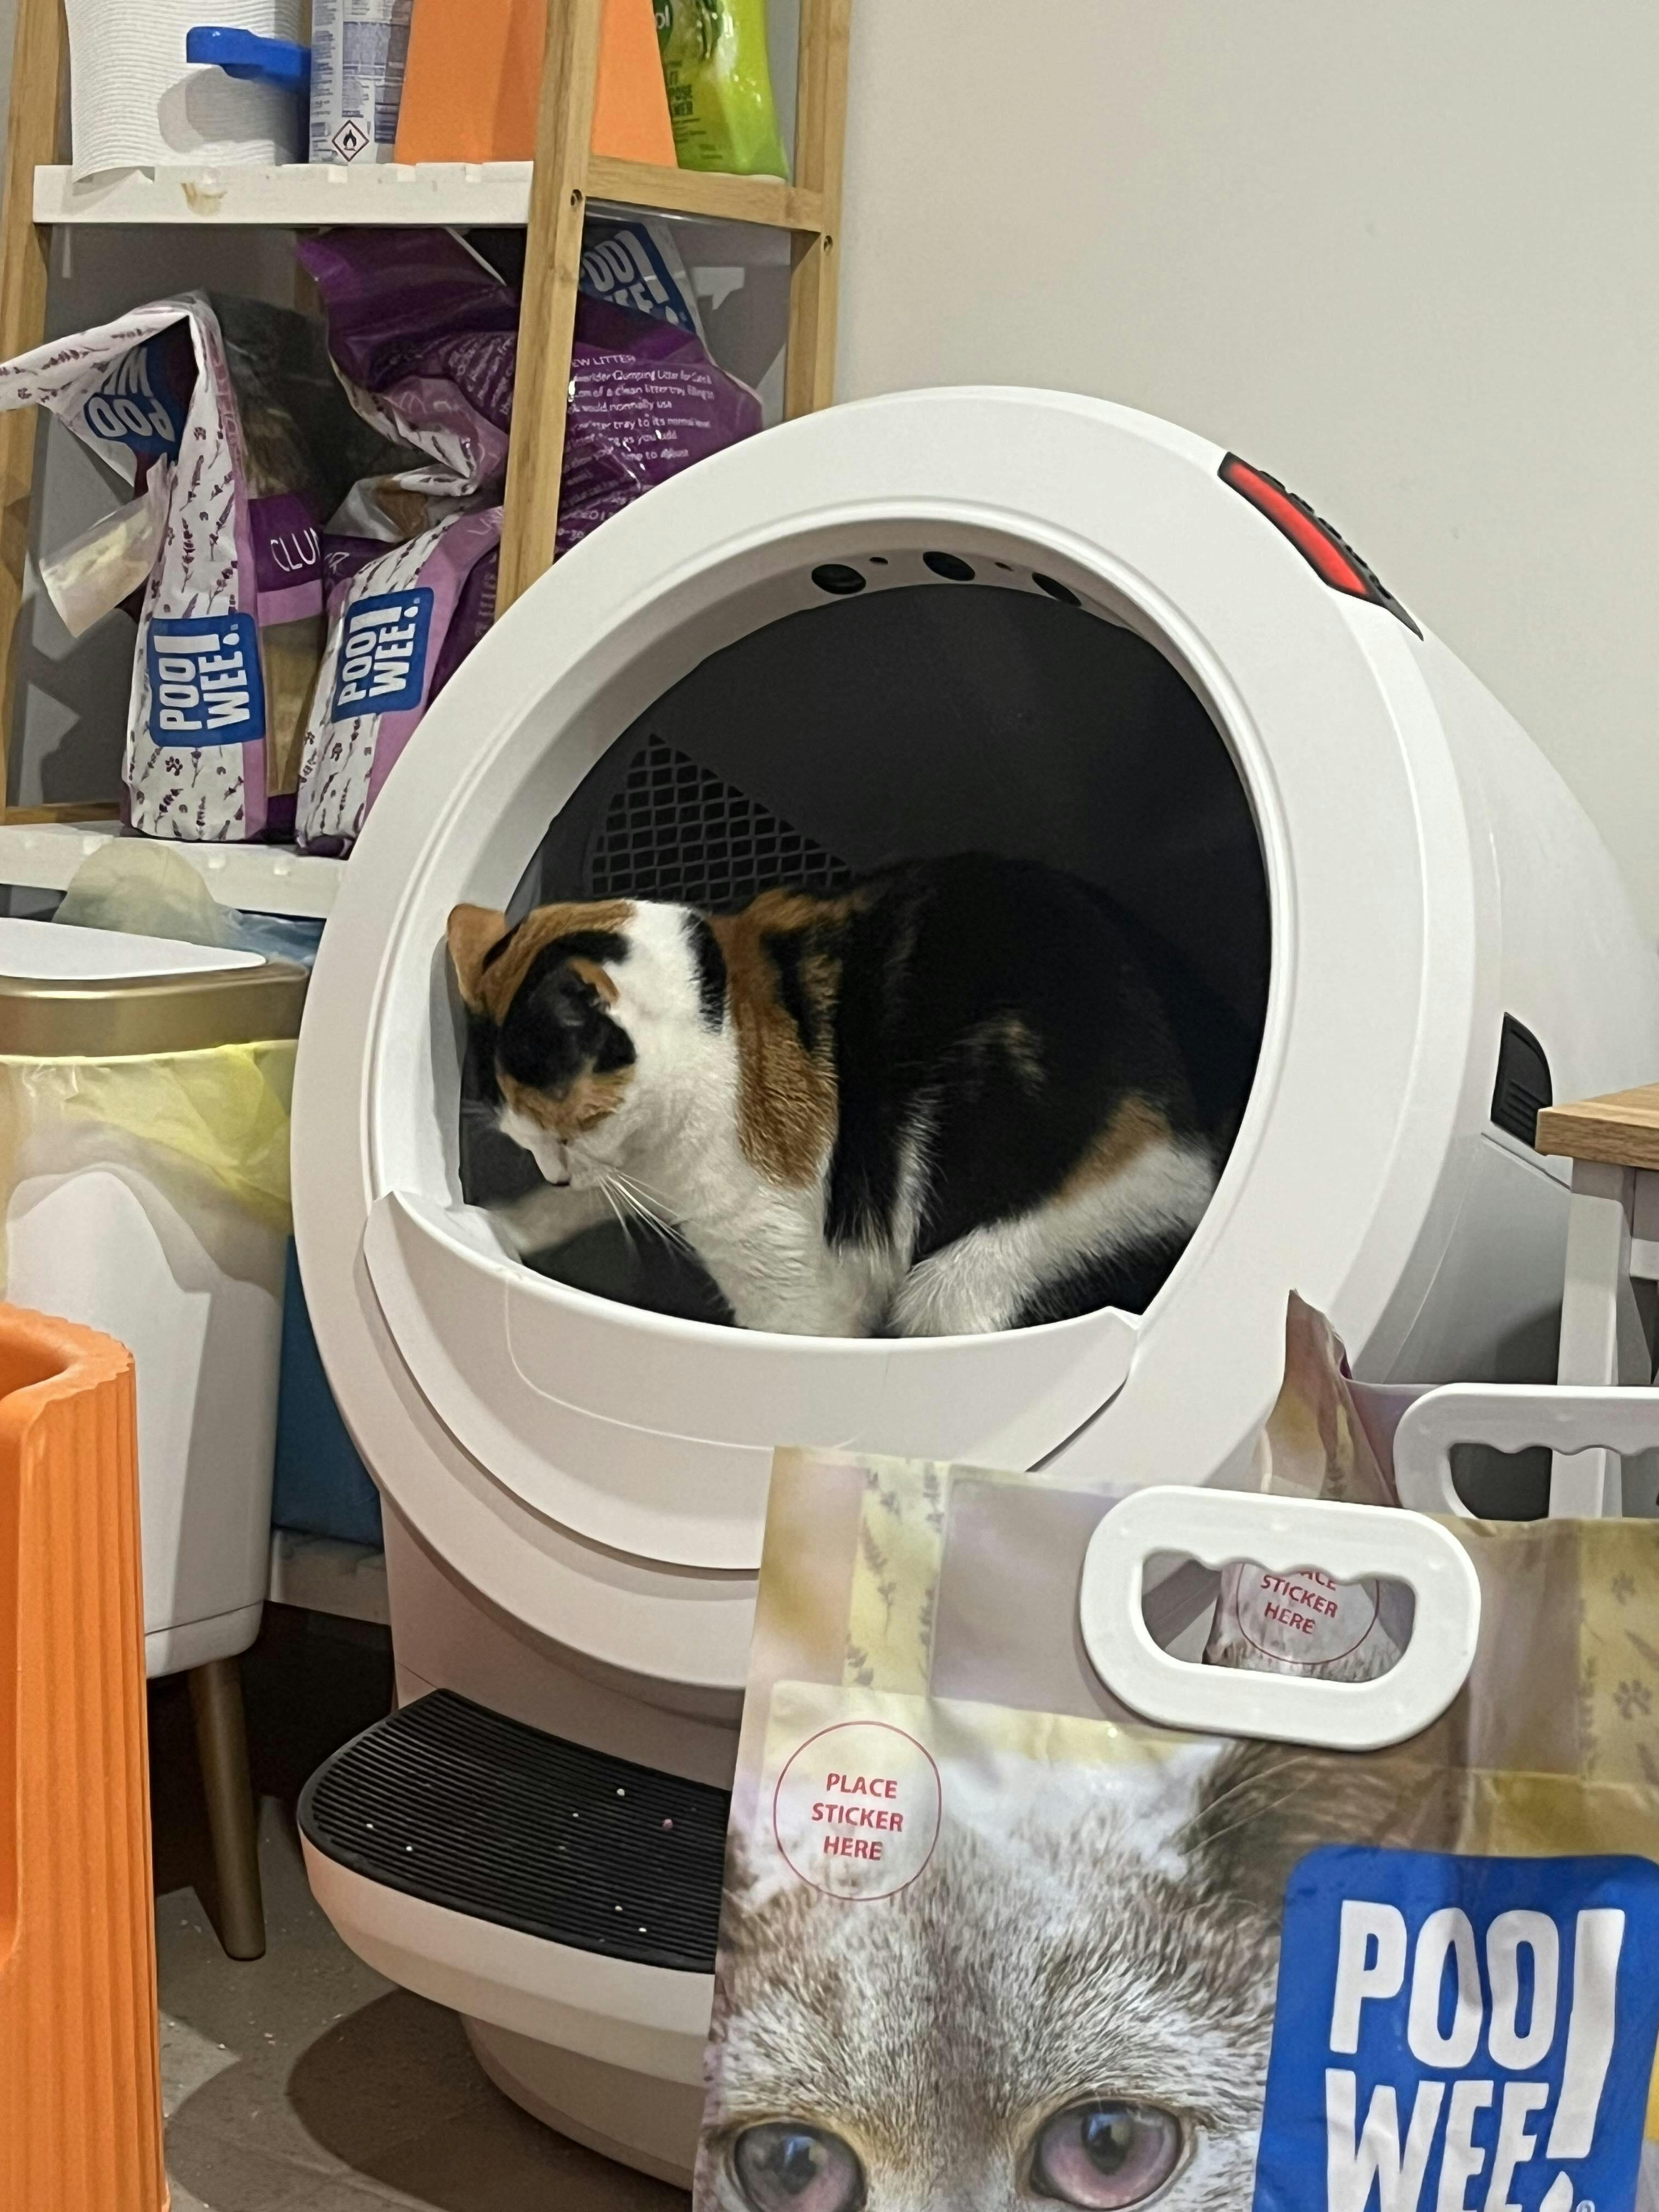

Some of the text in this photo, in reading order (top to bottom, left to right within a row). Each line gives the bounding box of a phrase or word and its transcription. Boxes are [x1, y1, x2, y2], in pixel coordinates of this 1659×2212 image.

[592, 354, 636, 365] LITTER
[1260, 1574, 1338, 1618] STICKER
[1264, 1601, 1316, 1634] HERE
[826, 1773, 898, 1799] PLACE
[811, 1803, 904, 1832] STICKER
[823, 1836, 883, 1861] HERE
